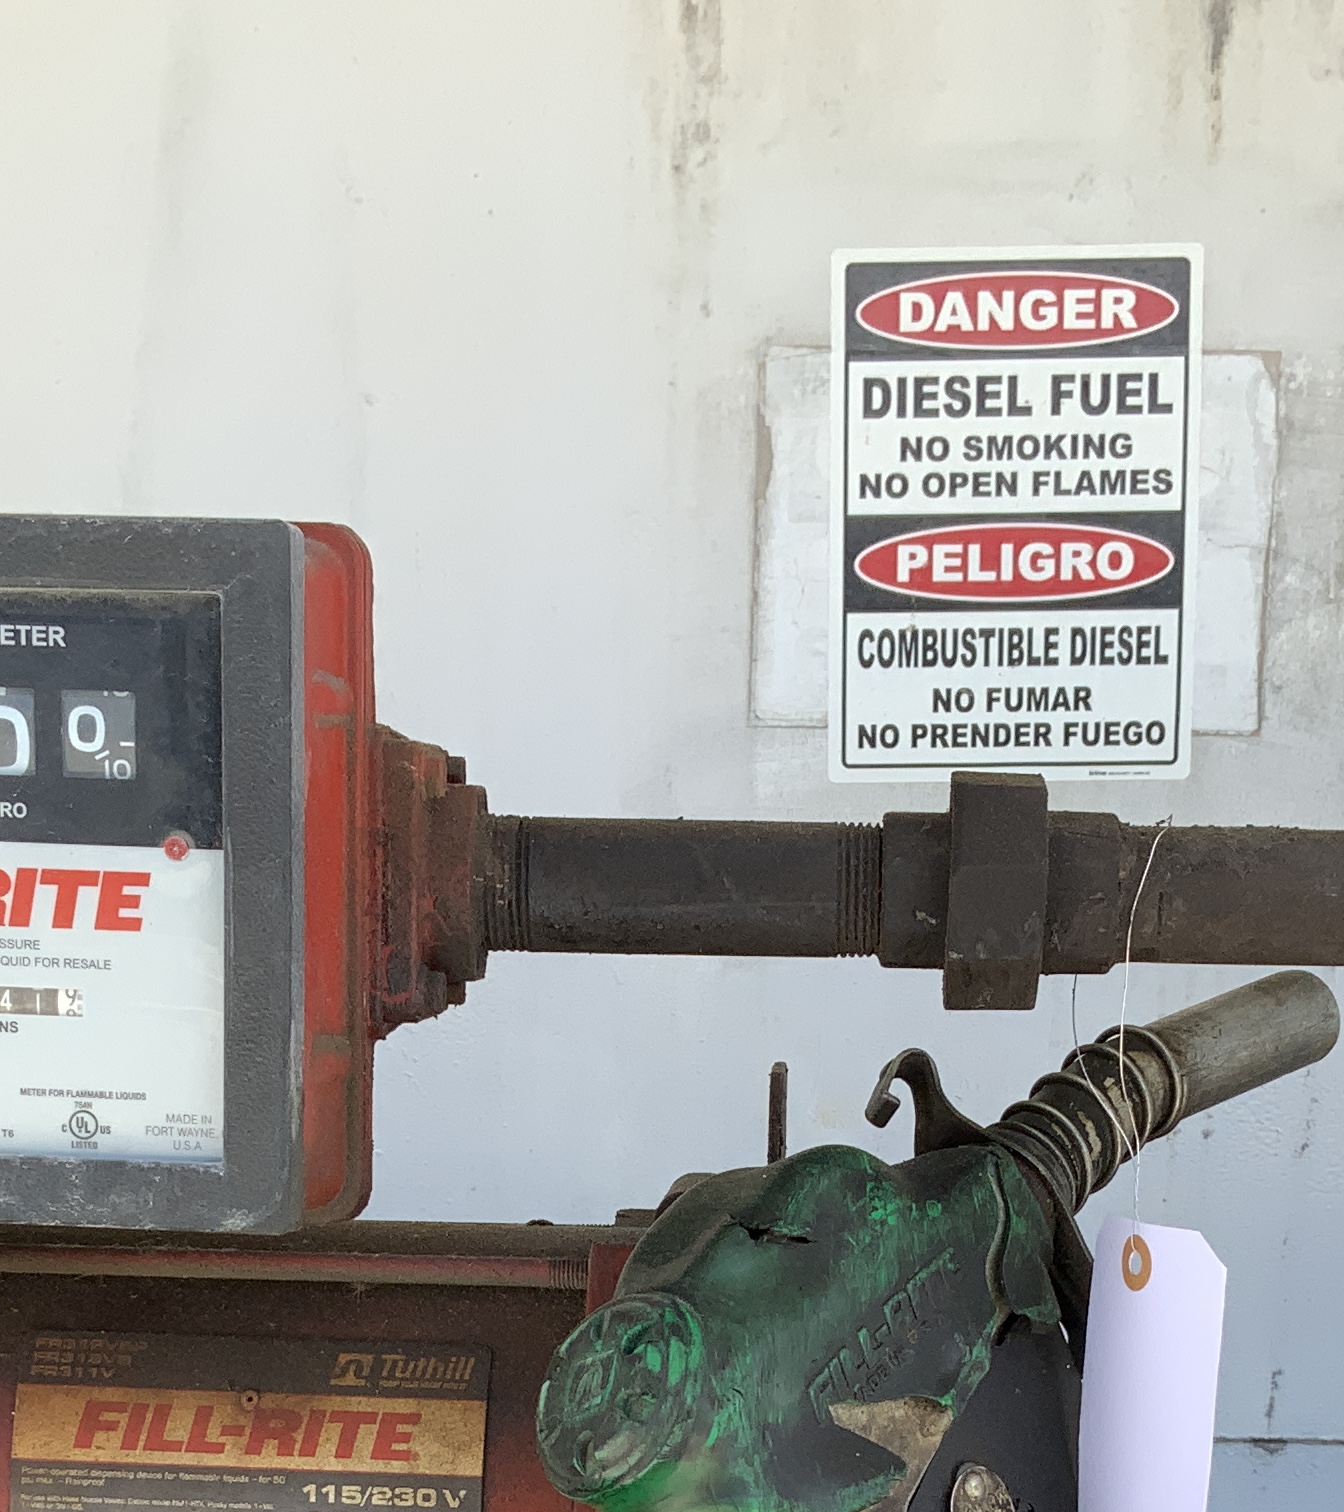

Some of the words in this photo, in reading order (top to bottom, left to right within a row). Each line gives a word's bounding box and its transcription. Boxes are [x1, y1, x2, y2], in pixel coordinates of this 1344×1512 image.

[900, 289, 1137, 332] DANGER
[863, 375, 1032, 419] DIESEL
[1051, 373, 1173, 416] FUEL
[900, 436, 949, 462] NO
[963, 433, 1132, 461] SMOKING
[860, 473, 909, 499] NO
[922, 472, 1017, 498] OPEN
[1033, 469, 1173, 496] FLAMES
[897, 542, 1134, 582] PELIGRO
[858, 626, 1059, 668] COMBUSTIBLE
[1070, 626, 1168, 666] DIESEL
[933, 688, 974, 713] NO
[987, 687, 1091, 712] FUMAR
[858, 724, 899, 748] NO
[911, 723, 1052, 748] PRENDER
[1063, 721, 1165, 746] FUEGO
[34, 957, 60, 968] FOR
[63, 958, 112, 970] RESALE
[20, 1088, 46, 1097] METER
[48, 1089, 65, 1097] FOR
[66, 1089, 114, 1099] FLAMMABLE
[115, 1091, 146, 1100] LIQUIDS
[146, 1126, 175, 1136] FORT
[166, 1114, 199, 1124] MADE
[202, 1115, 212, 1124] IN
[2, 1129, 14, 1138] T6
[71, 1141, 98, 1149] LISTED
[381, 1355, 475, 1379] Tuthill
[73, 1400, 422, 1461] FILL-RITE
[259, 1475, 271, 1483] for
[302, 1484, 437, 1507] 115/230
[442, 1489, 467, 1508] V
